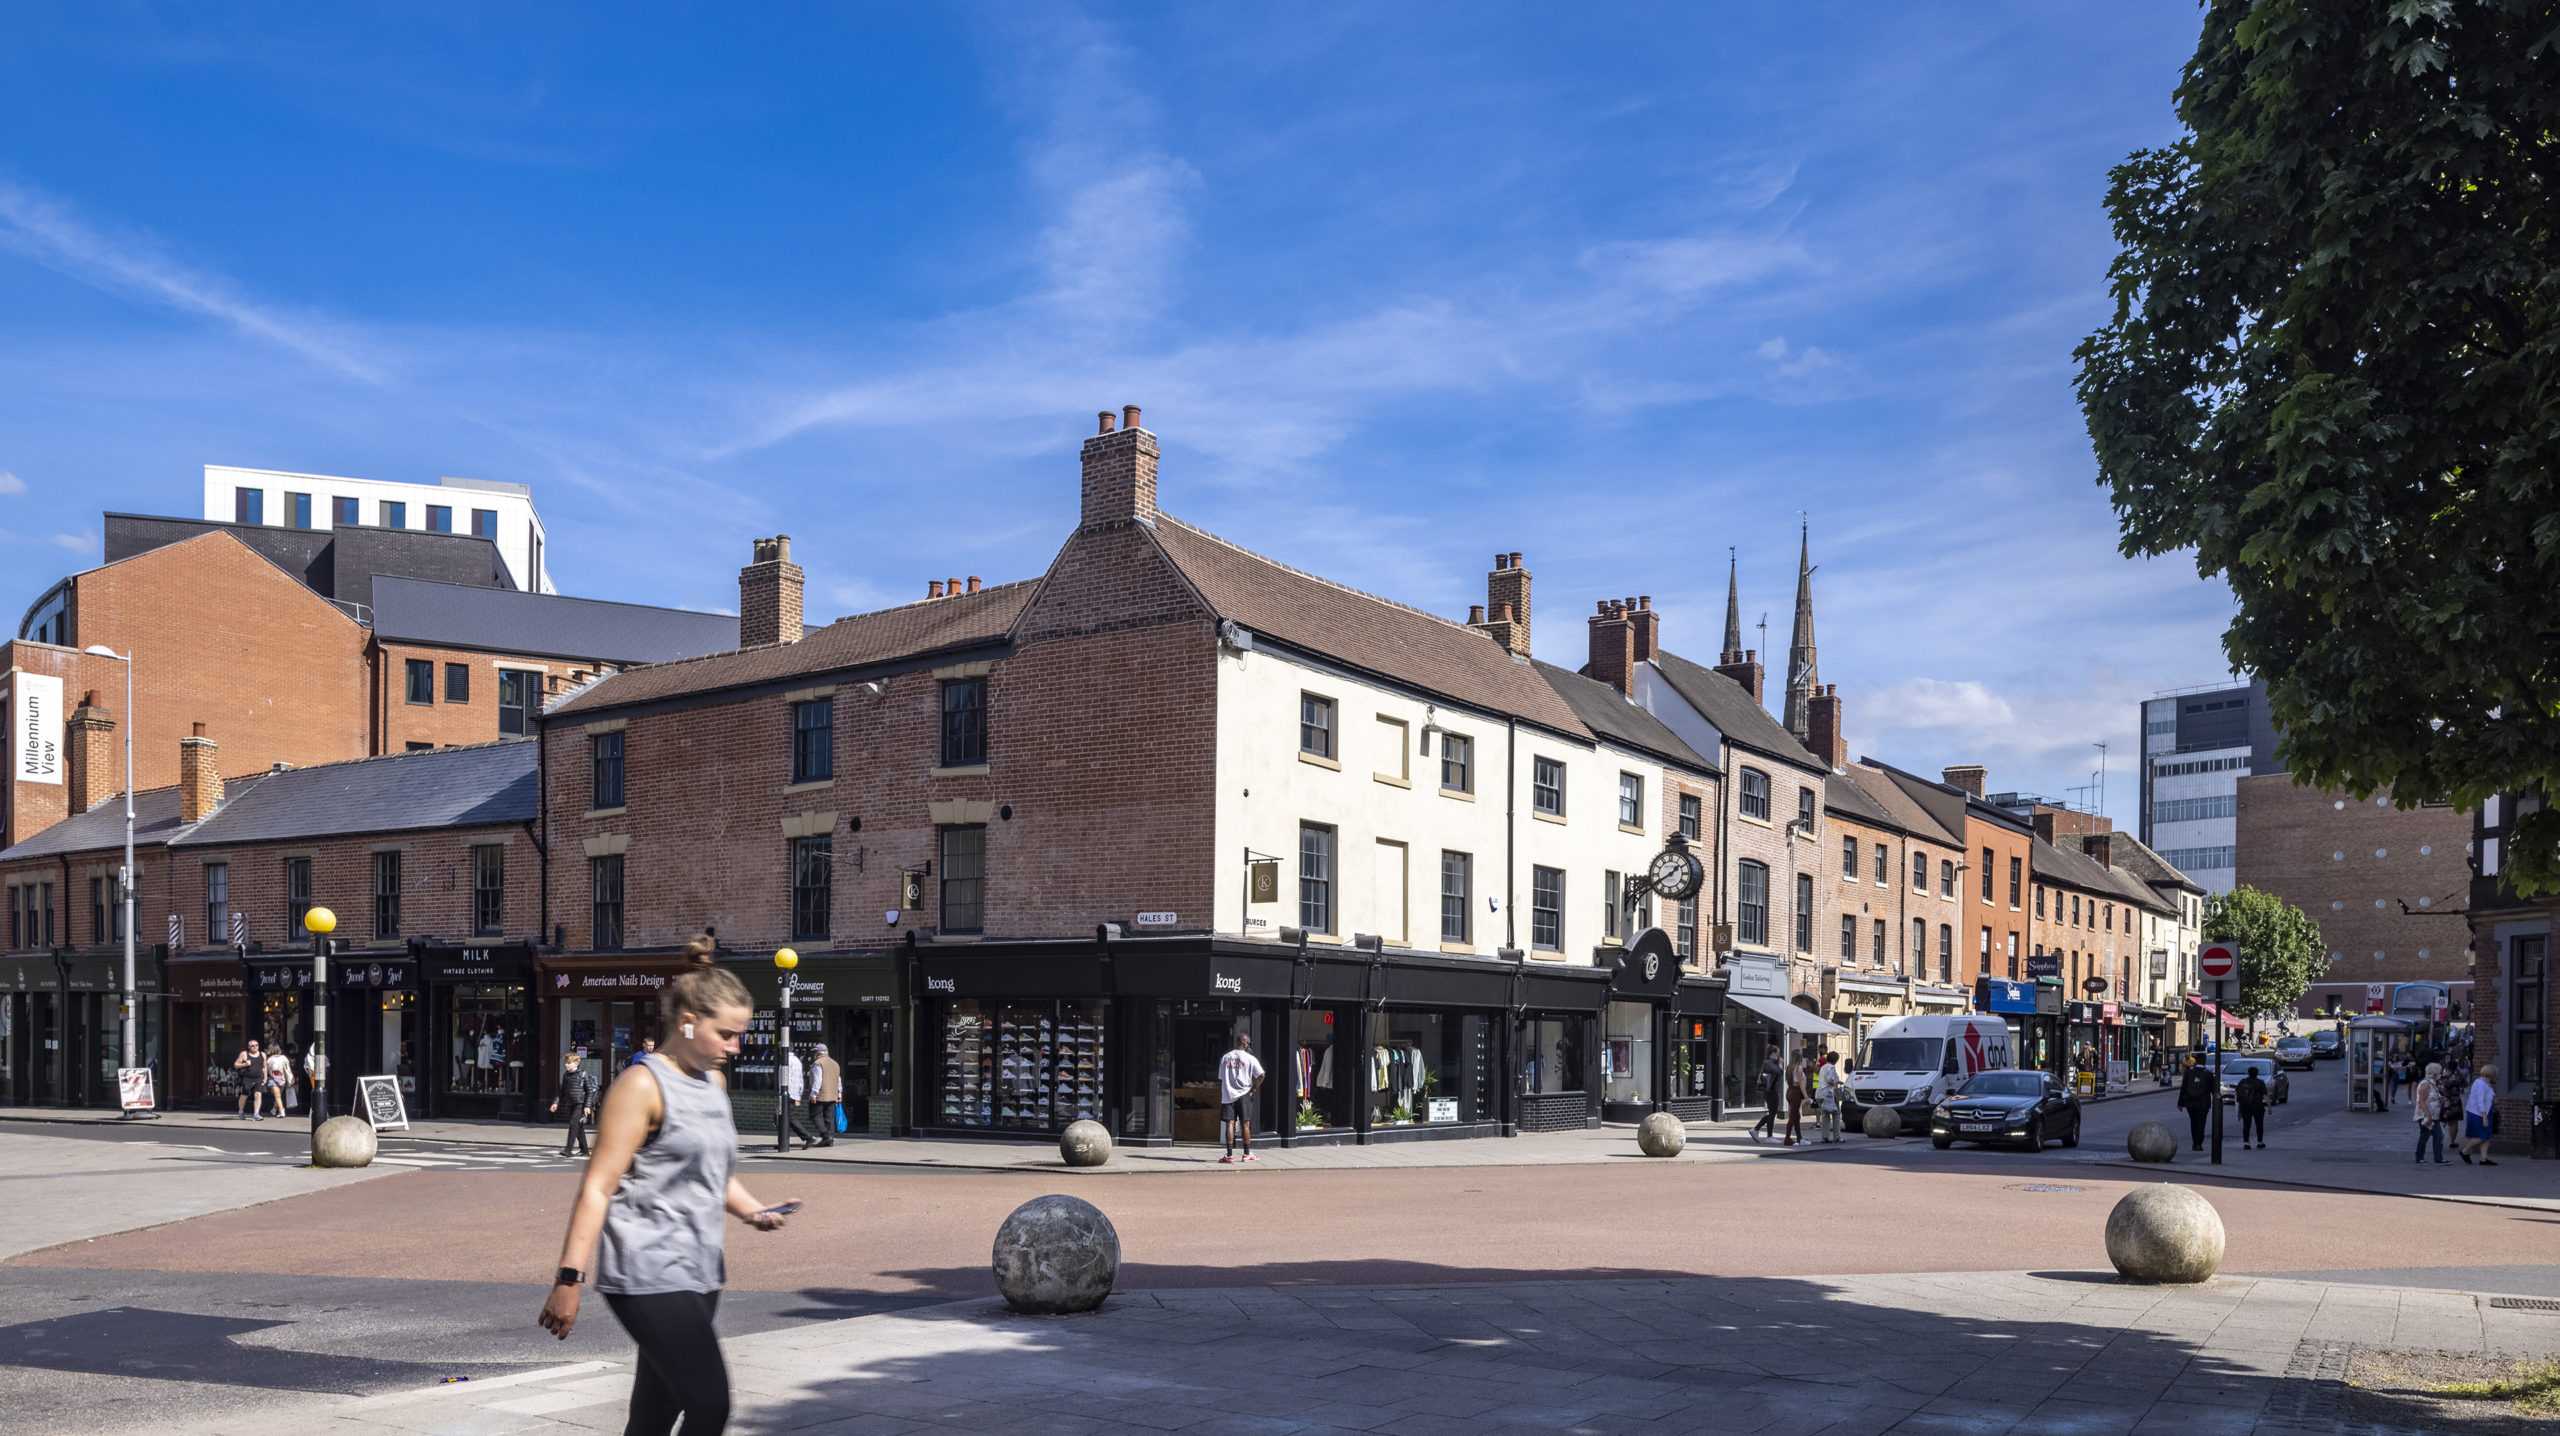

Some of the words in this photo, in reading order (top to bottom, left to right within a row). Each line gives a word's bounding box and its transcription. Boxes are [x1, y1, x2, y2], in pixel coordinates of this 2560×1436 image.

[25, 696, 39, 774] Millennium
[41, 741, 55, 774] View
[1140, 914, 1162, 923] HALES
[1165, 914, 1175, 922] ST
[463, 949, 489, 961] MILK
[443, 967, 465, 975] VINTAGE
[467, 967, 494, 975] CLOTHING
[582, 976, 617, 987] American
[618, 974, 638, 986] Nails
[640, 974, 665, 989] Design
[795, 982, 825, 991] CONNECT
[928, 976, 955, 993] kong
[1215, 973, 1241, 993] kong
[1988, 1036, 2007, 1068] dpd
